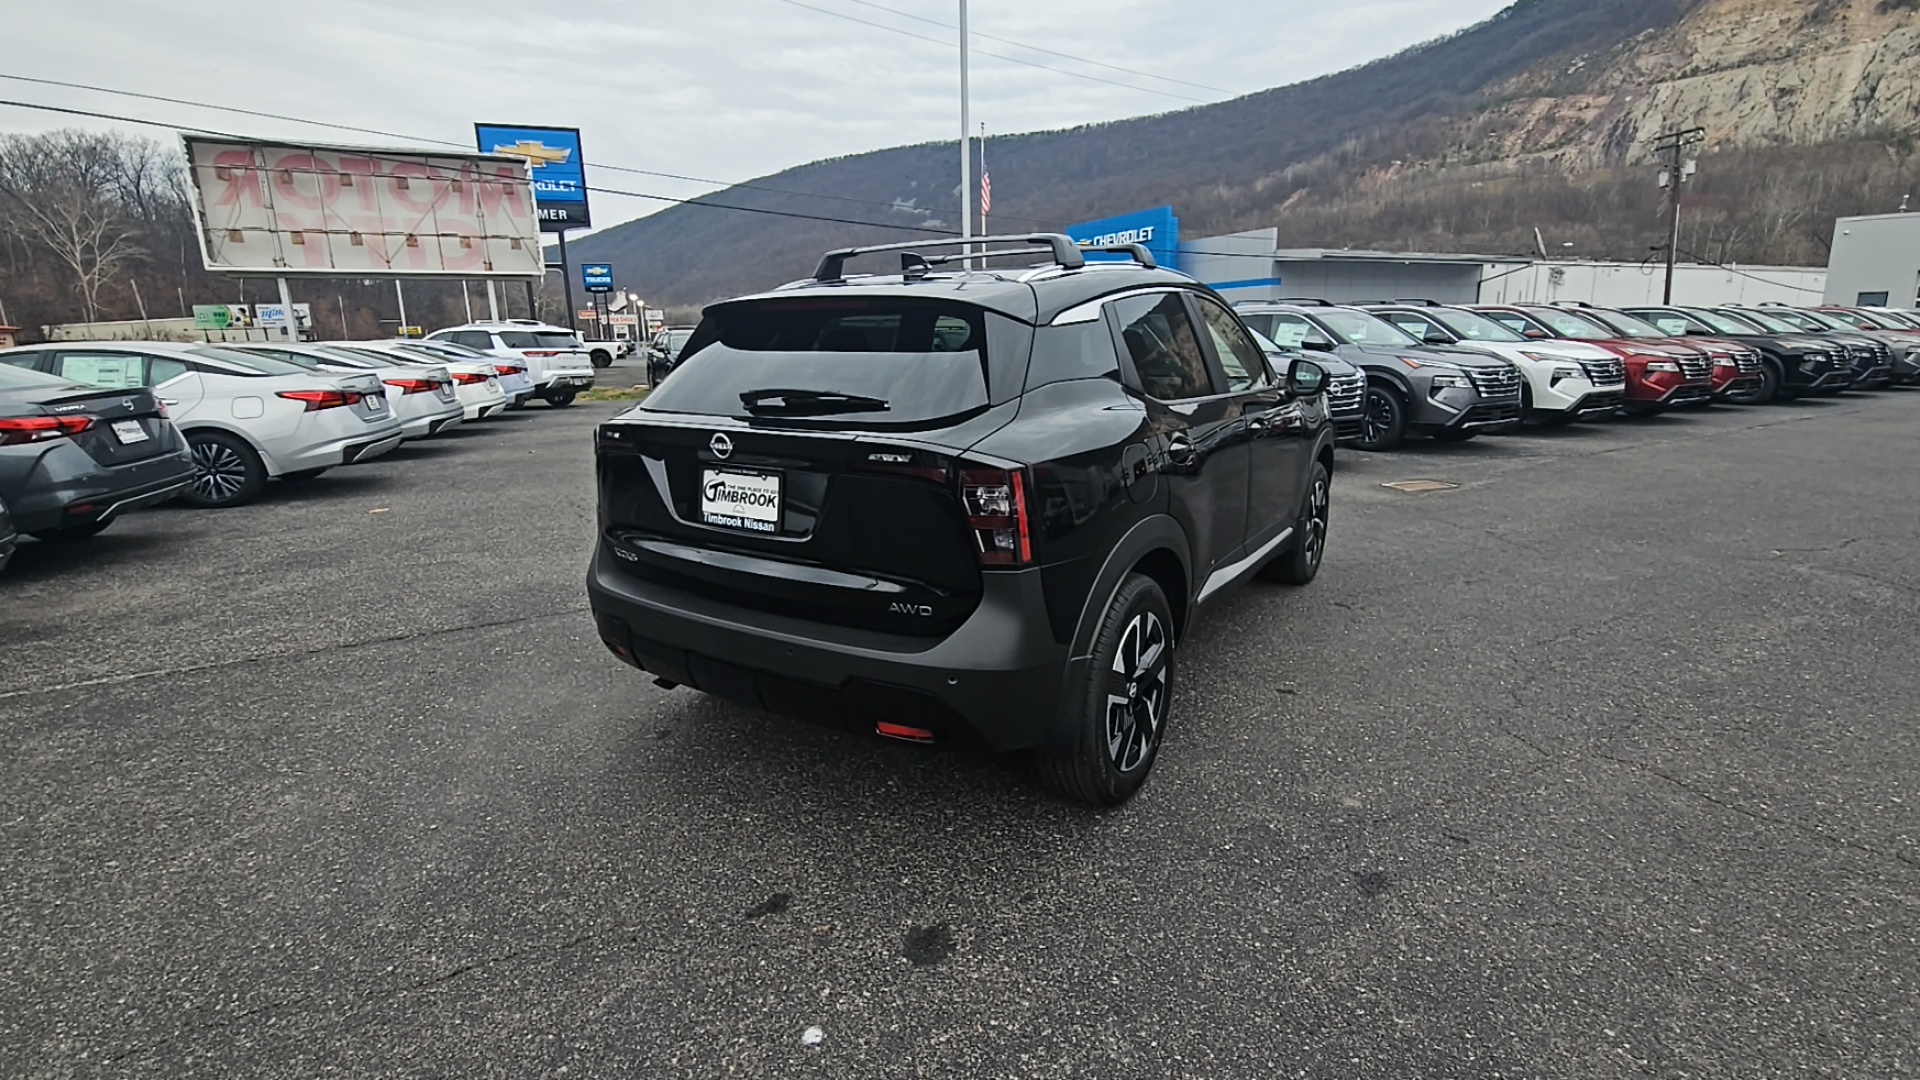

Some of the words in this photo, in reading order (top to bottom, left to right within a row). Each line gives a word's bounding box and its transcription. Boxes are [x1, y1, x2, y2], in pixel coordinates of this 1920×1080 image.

[538, 208, 568, 220] MER
[1093, 226, 1155, 245] CHEVROLET
[704, 479, 776, 508] TIMBROOK
[704, 512, 742, 527] Timbrook
[744, 519, 774, 531] Nissan
[888, 602, 932, 616] AWD
